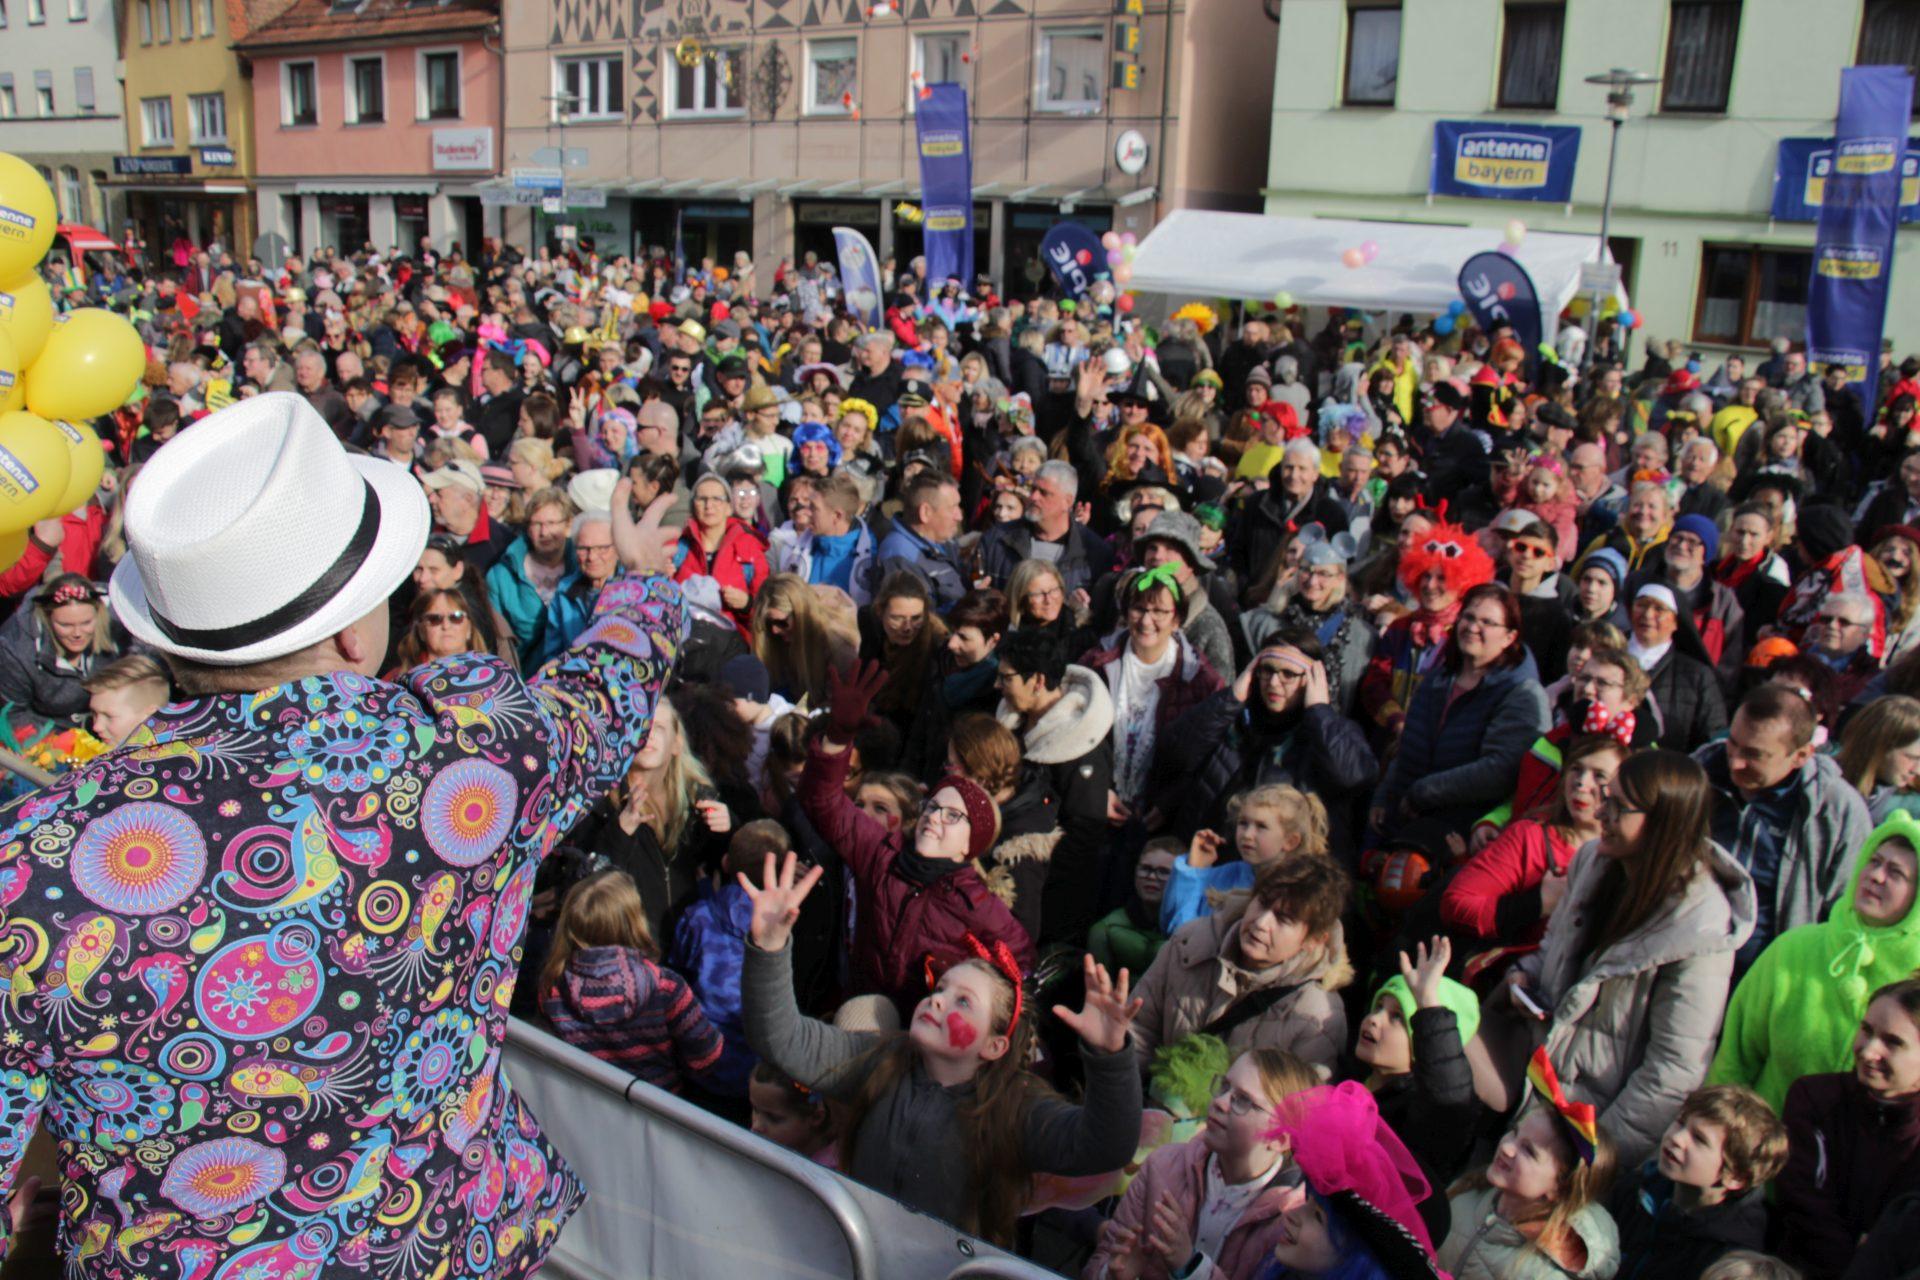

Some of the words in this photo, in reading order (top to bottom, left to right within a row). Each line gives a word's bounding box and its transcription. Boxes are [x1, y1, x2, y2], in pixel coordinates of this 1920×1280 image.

[203, 151, 233, 163] KIND
[1463, 138, 1545, 159] antenne
[1468, 162, 1534, 183] bayern
[1662, 240, 1678, 257] 11
